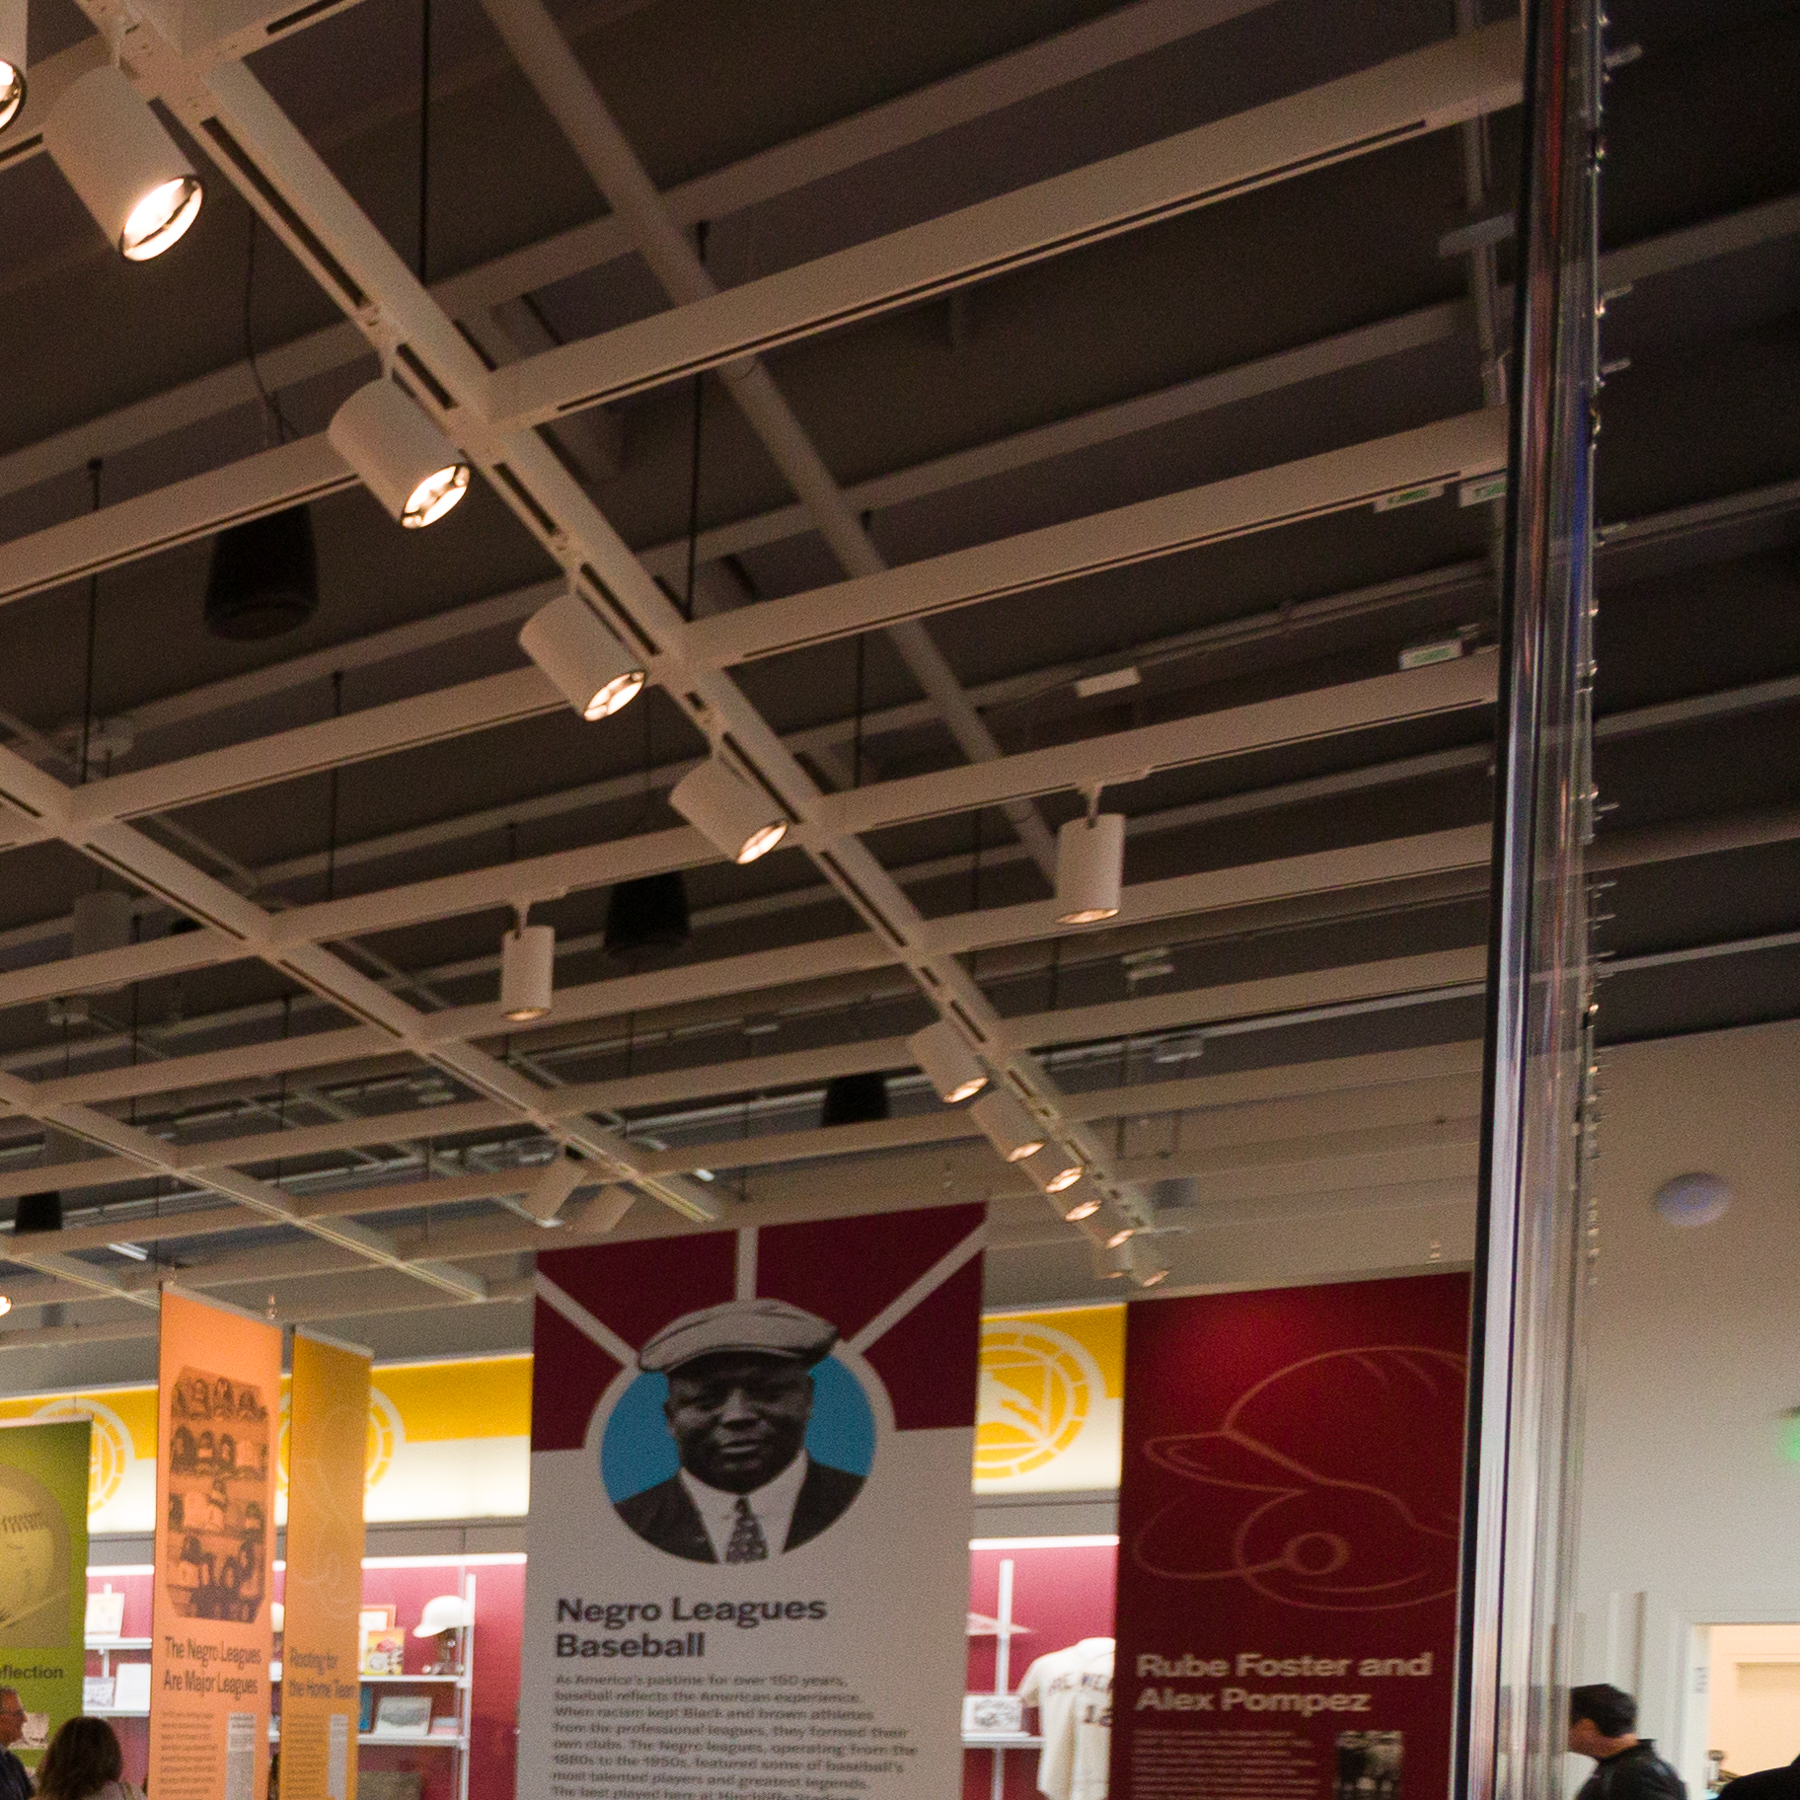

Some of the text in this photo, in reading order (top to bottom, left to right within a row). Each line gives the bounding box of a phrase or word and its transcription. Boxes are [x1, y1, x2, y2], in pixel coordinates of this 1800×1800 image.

[558, 1596, 827, 1630] Negro Leagues
[165, 1636, 262, 1670] The Negro Leagues
[557, 1632, 705, 1657] Baseball
[1137, 1652, 1433, 1677] Rube Foster and
[164, 1670, 258, 1700] Are Major Leagues
[1135, 1687, 1371, 1718] Alex Pompez
